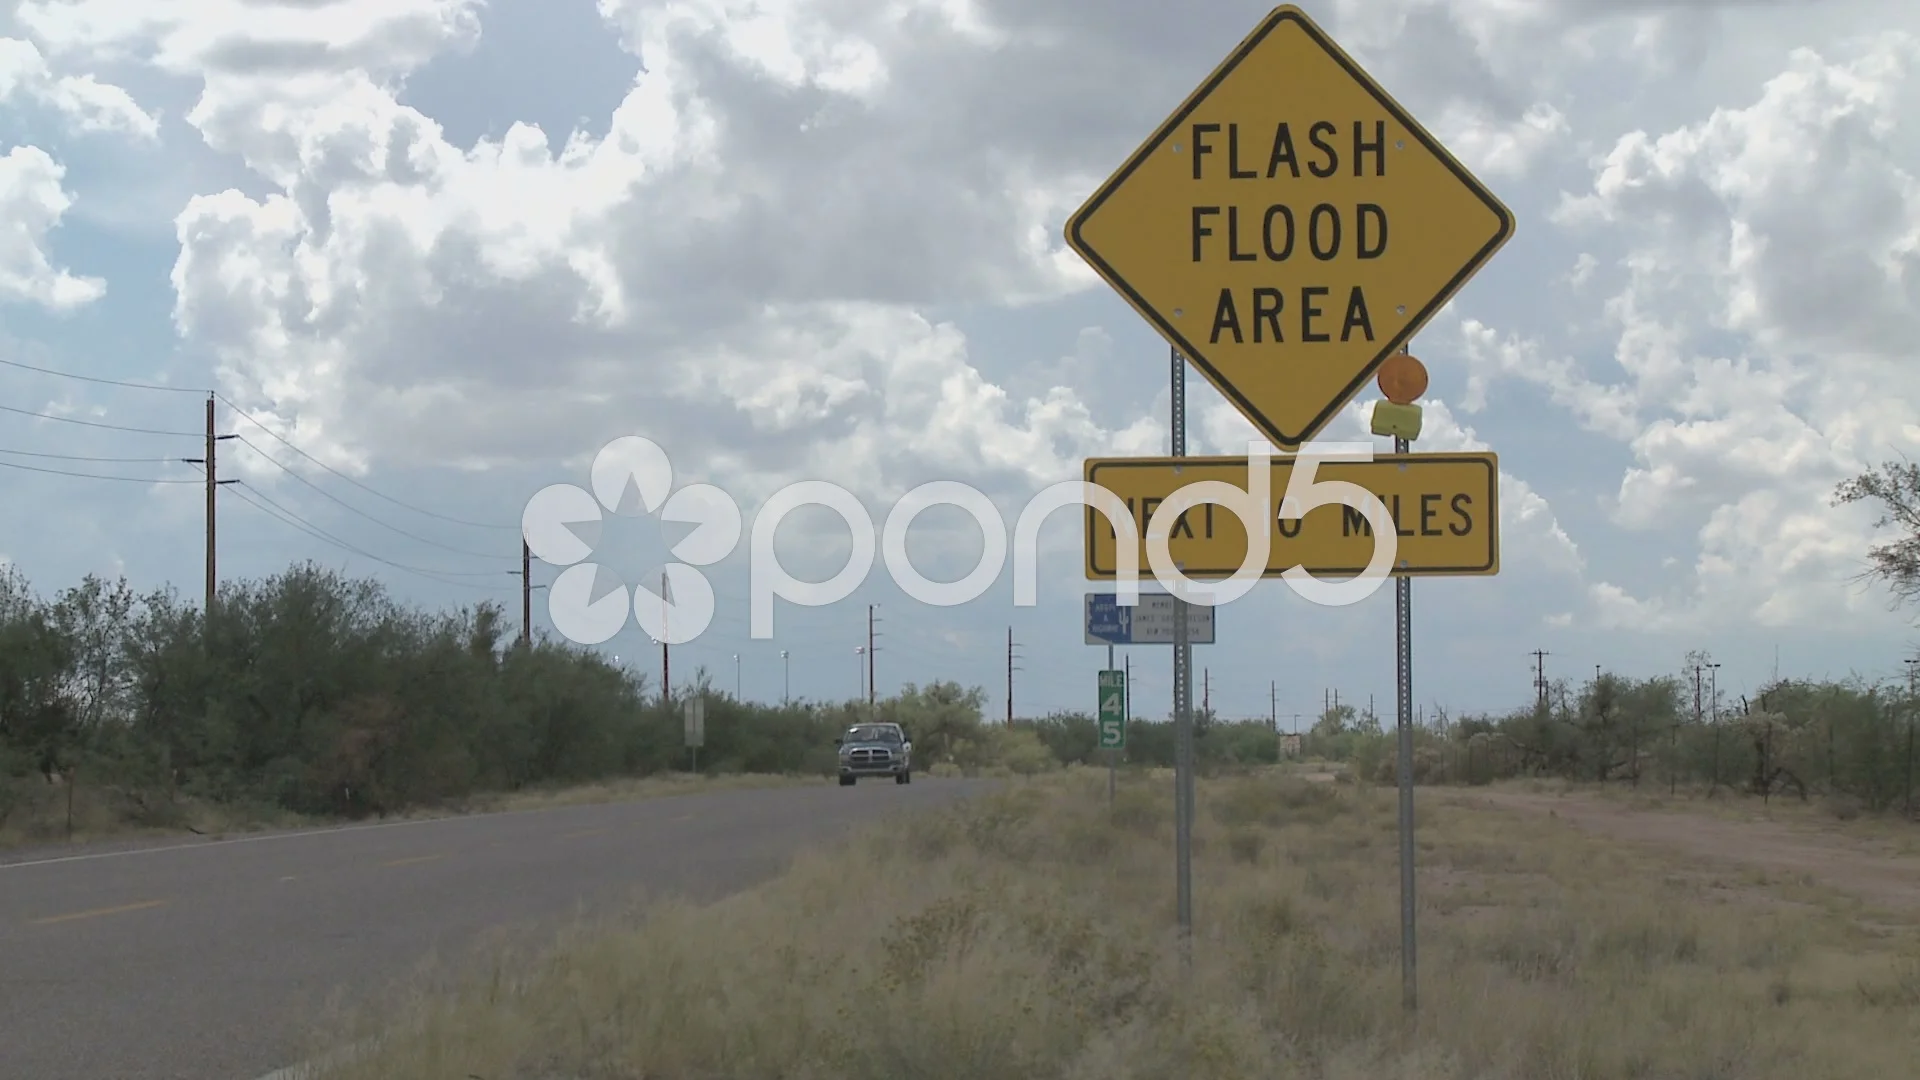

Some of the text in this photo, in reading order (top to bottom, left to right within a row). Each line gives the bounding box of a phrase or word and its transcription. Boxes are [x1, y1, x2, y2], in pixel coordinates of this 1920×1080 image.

[1192, 121, 1385, 180] FLASH
[1192, 203, 1388, 262] FLOOD
[1209, 286, 1375, 344] AREA
[1111, 497, 1215, 540] NEXT
[1343, 493, 1473, 538] MILES
[1100, 675, 1122, 688] MILE
